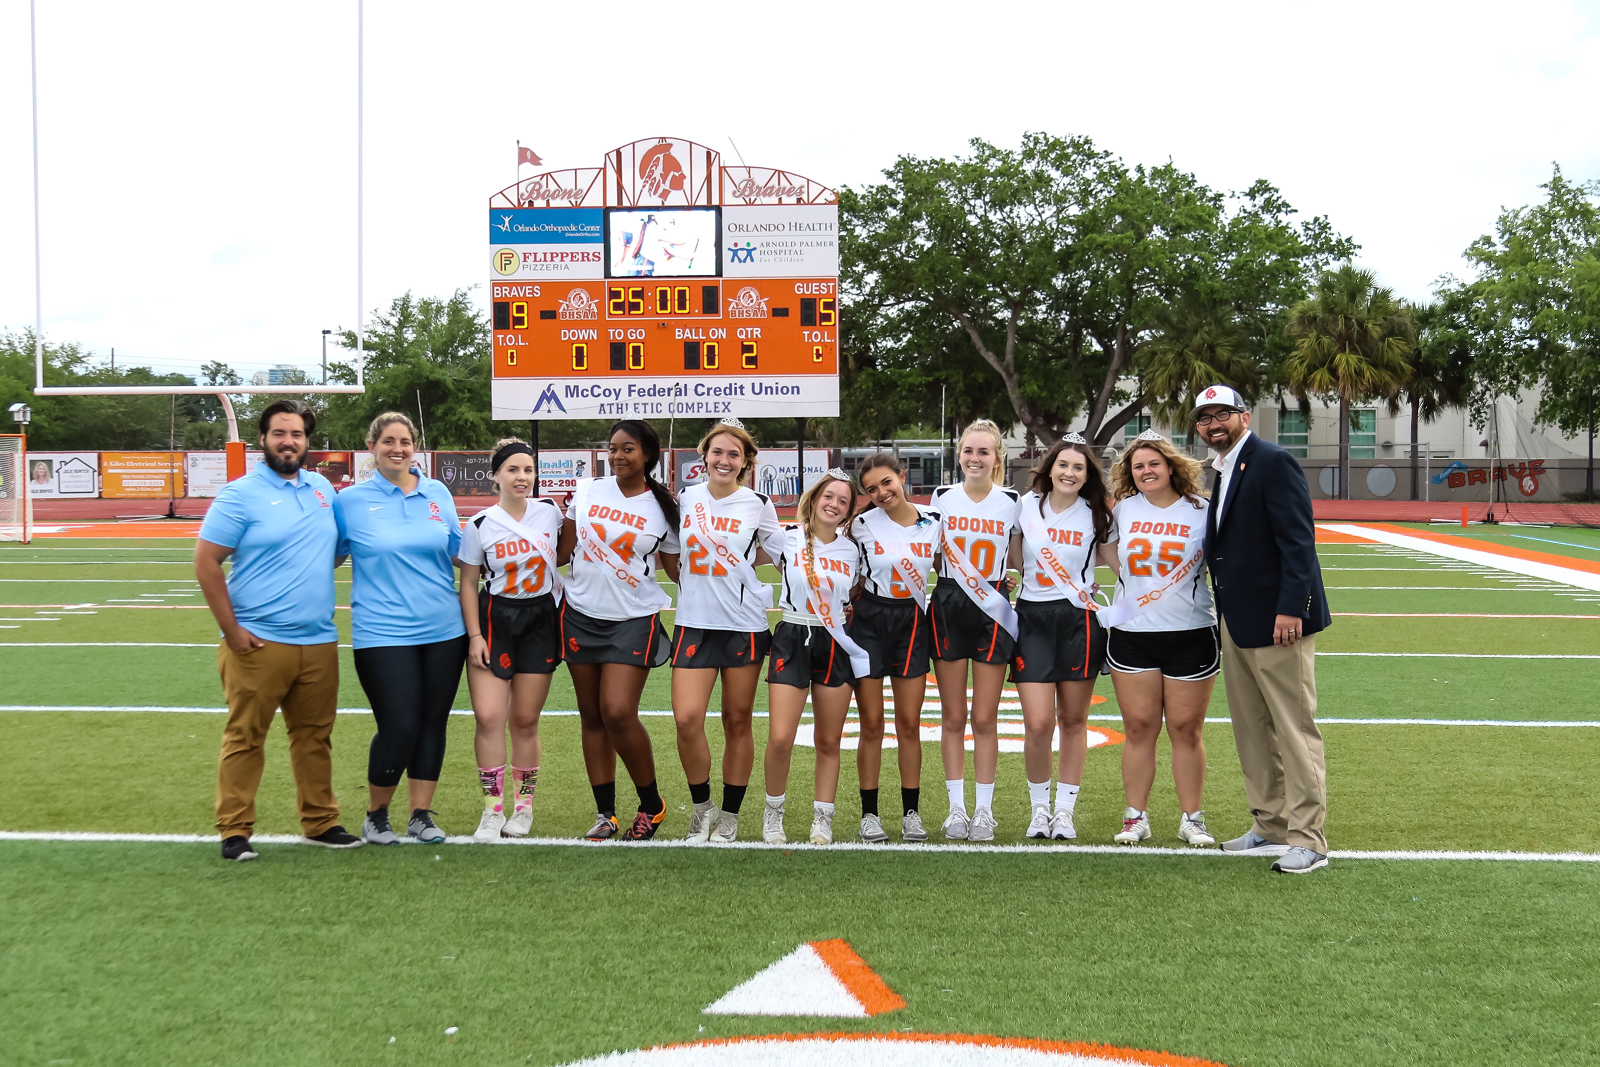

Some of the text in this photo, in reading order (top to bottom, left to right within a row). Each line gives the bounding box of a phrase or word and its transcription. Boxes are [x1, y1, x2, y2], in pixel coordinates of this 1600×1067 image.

[520, 181, 584, 201] Boone
[733, 178, 805, 198] Braves
[513, 223, 539, 232] Orlando
[578, 223, 601, 232] Center
[728, 222, 833, 232] ORLANDO HEALTH
[522, 252, 601, 262] FLIPPERS
[493, 286, 541, 298] BRAVES
[794, 283, 835, 294] GUEST
[512, 302, 528, 329] 9
[561, 311, 597, 320] BHSAA
[730, 309, 766, 318] BHSAA
[819, 298, 835, 326] 5
[497, 334, 529, 346] T.O.L.
[561, 329, 598, 341] DOWN
[608, 329, 646, 340] TO GO
[675, 328, 727, 339] BALL ON
[736, 328, 762, 339] QTR
[803, 331, 835, 342] T.O.L.
[572, 343, 588, 371] 0
[628, 342, 645, 370] 0
[703, 341, 719, 369] 0
[741, 341, 757, 369] 2
[564, 382, 800, 400] McCoy Federal Credit Union
[599, 401, 731, 414] ATHLETIC COMPLEX
[538, 460, 573, 469] inaldi
[1448, 459, 1546, 488] BRAVE
[538, 479, 577, 488] 82-290
[588, 505, 647, 531] BOONE
[683, 514, 742, 534] BNE
[948, 516, 1004, 536] BOONE
[1129, 521, 1191, 538] BOONE
[874, 541, 932, 558] BNE
[1127, 537, 1185, 577] 25
[503, 556, 547, 594] 13
